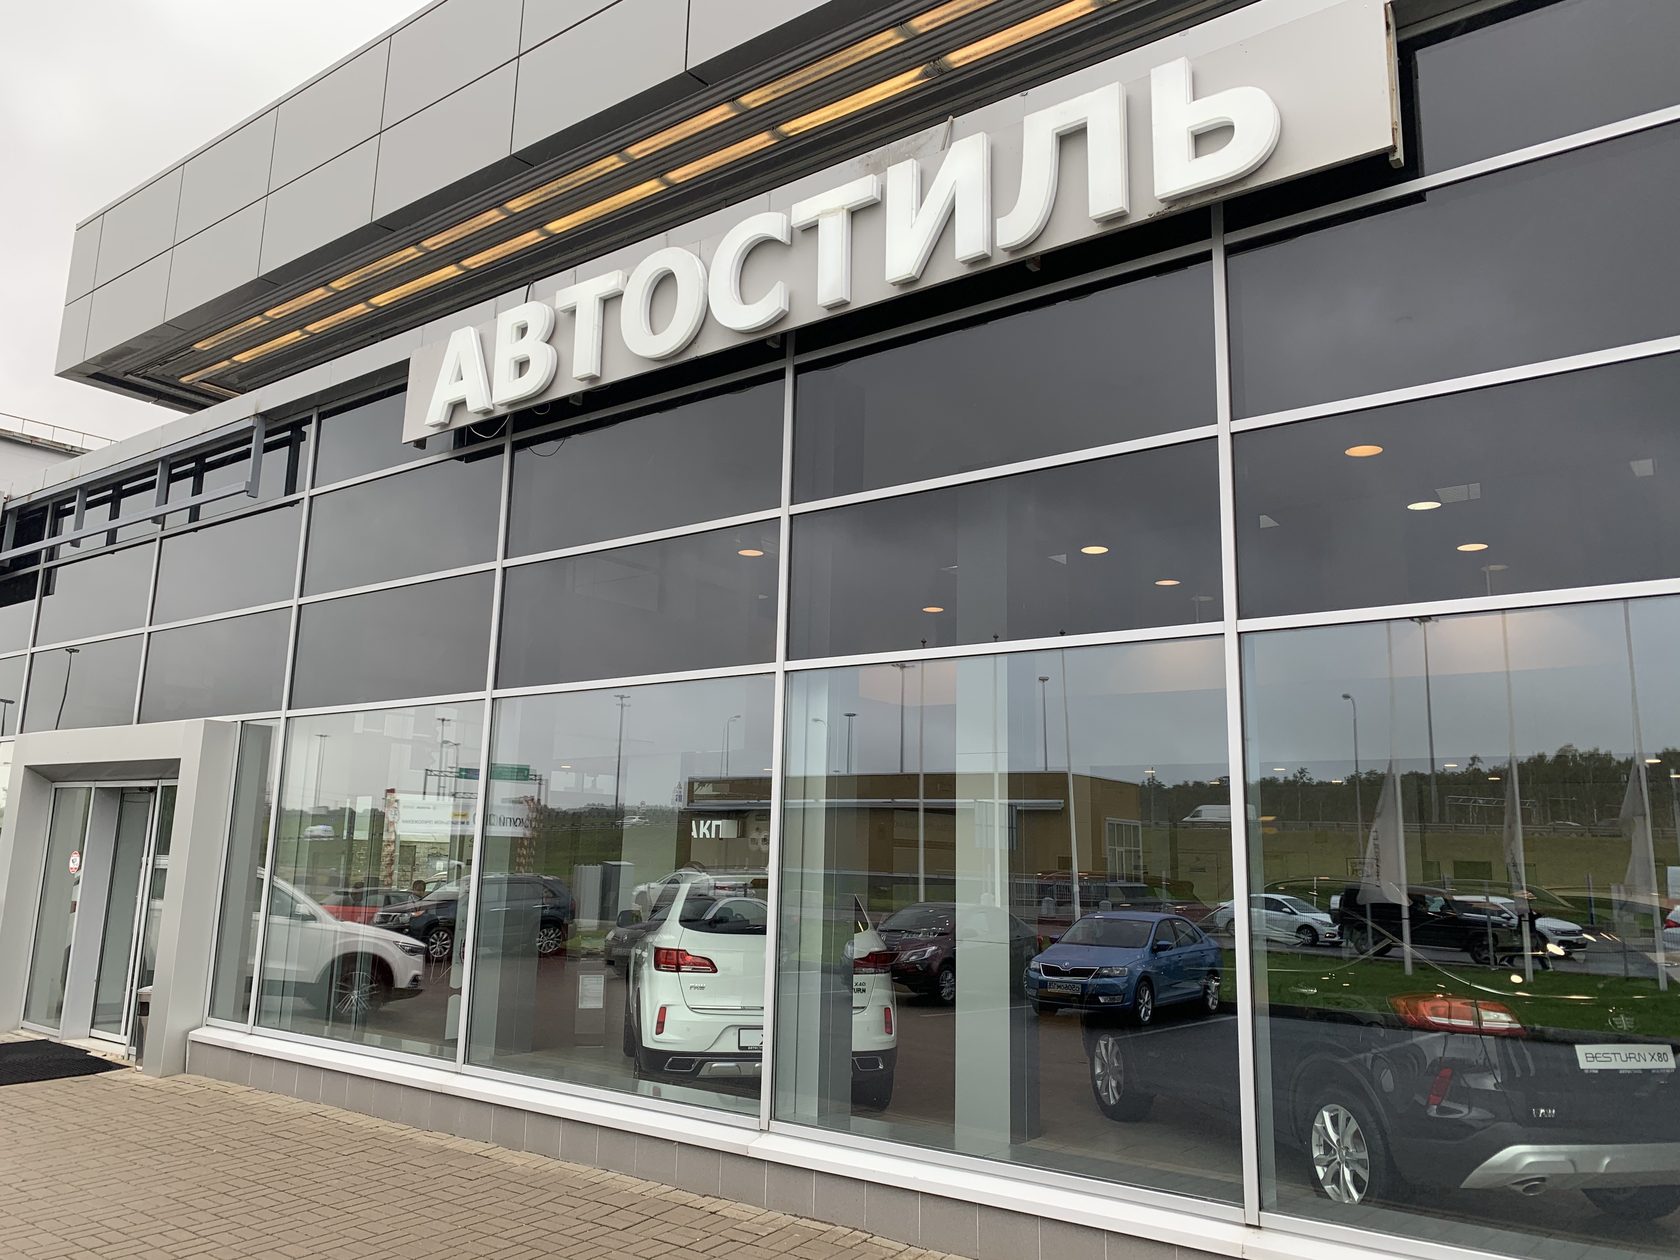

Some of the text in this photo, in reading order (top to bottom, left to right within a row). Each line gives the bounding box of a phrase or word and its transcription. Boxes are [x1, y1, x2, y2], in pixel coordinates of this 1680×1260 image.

[424, 56, 1281, 427] АВТОСТИЛЬ
[1585, 1052, 1669, 1063] BESTURN X80
